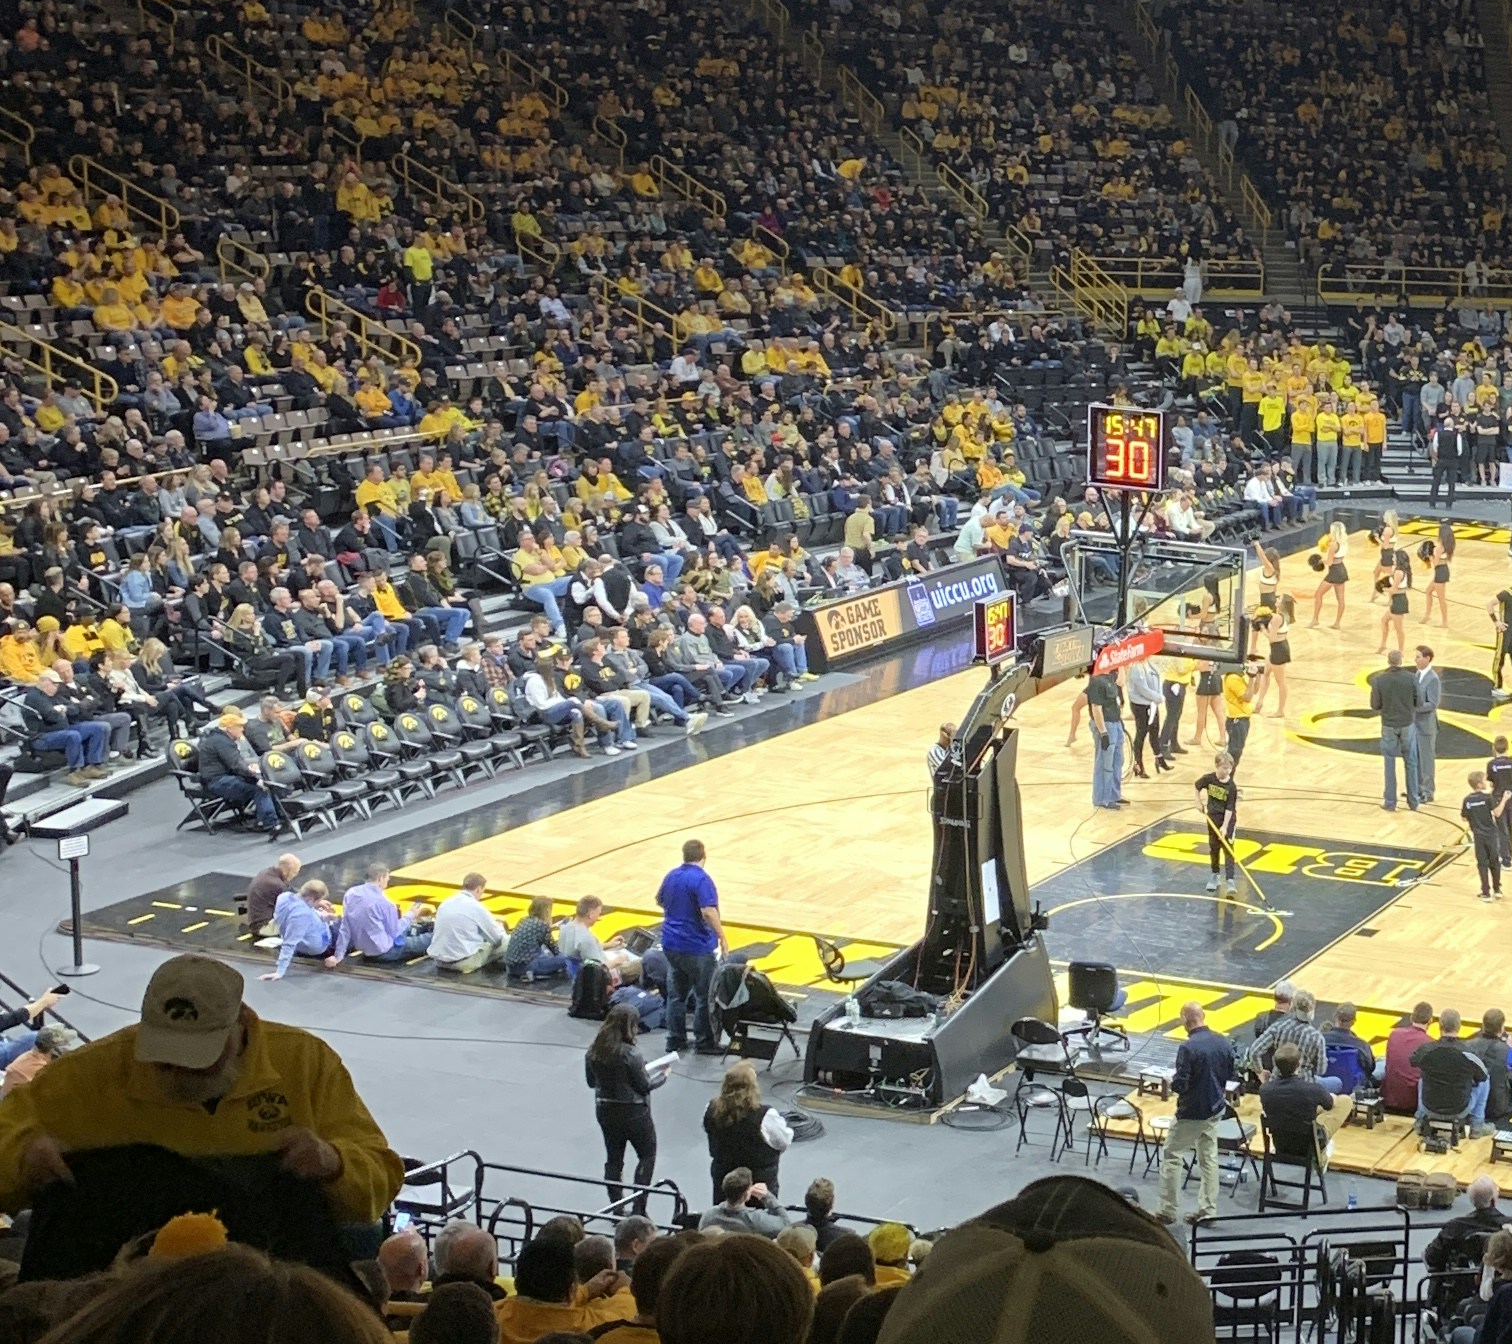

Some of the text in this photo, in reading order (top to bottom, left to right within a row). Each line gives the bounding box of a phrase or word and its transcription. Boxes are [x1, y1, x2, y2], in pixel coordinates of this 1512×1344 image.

[1106, 415, 1156, 439] 15:47
[1105, 438, 1150, 480] 30
[931, 573, 999, 610] uiccu.org
[846, 598, 882, 625] GAME
[830, 619, 887, 652] SPONSOR
[988, 622, 1005, 651] 30
[248, 1089, 288, 1111] IOWA
